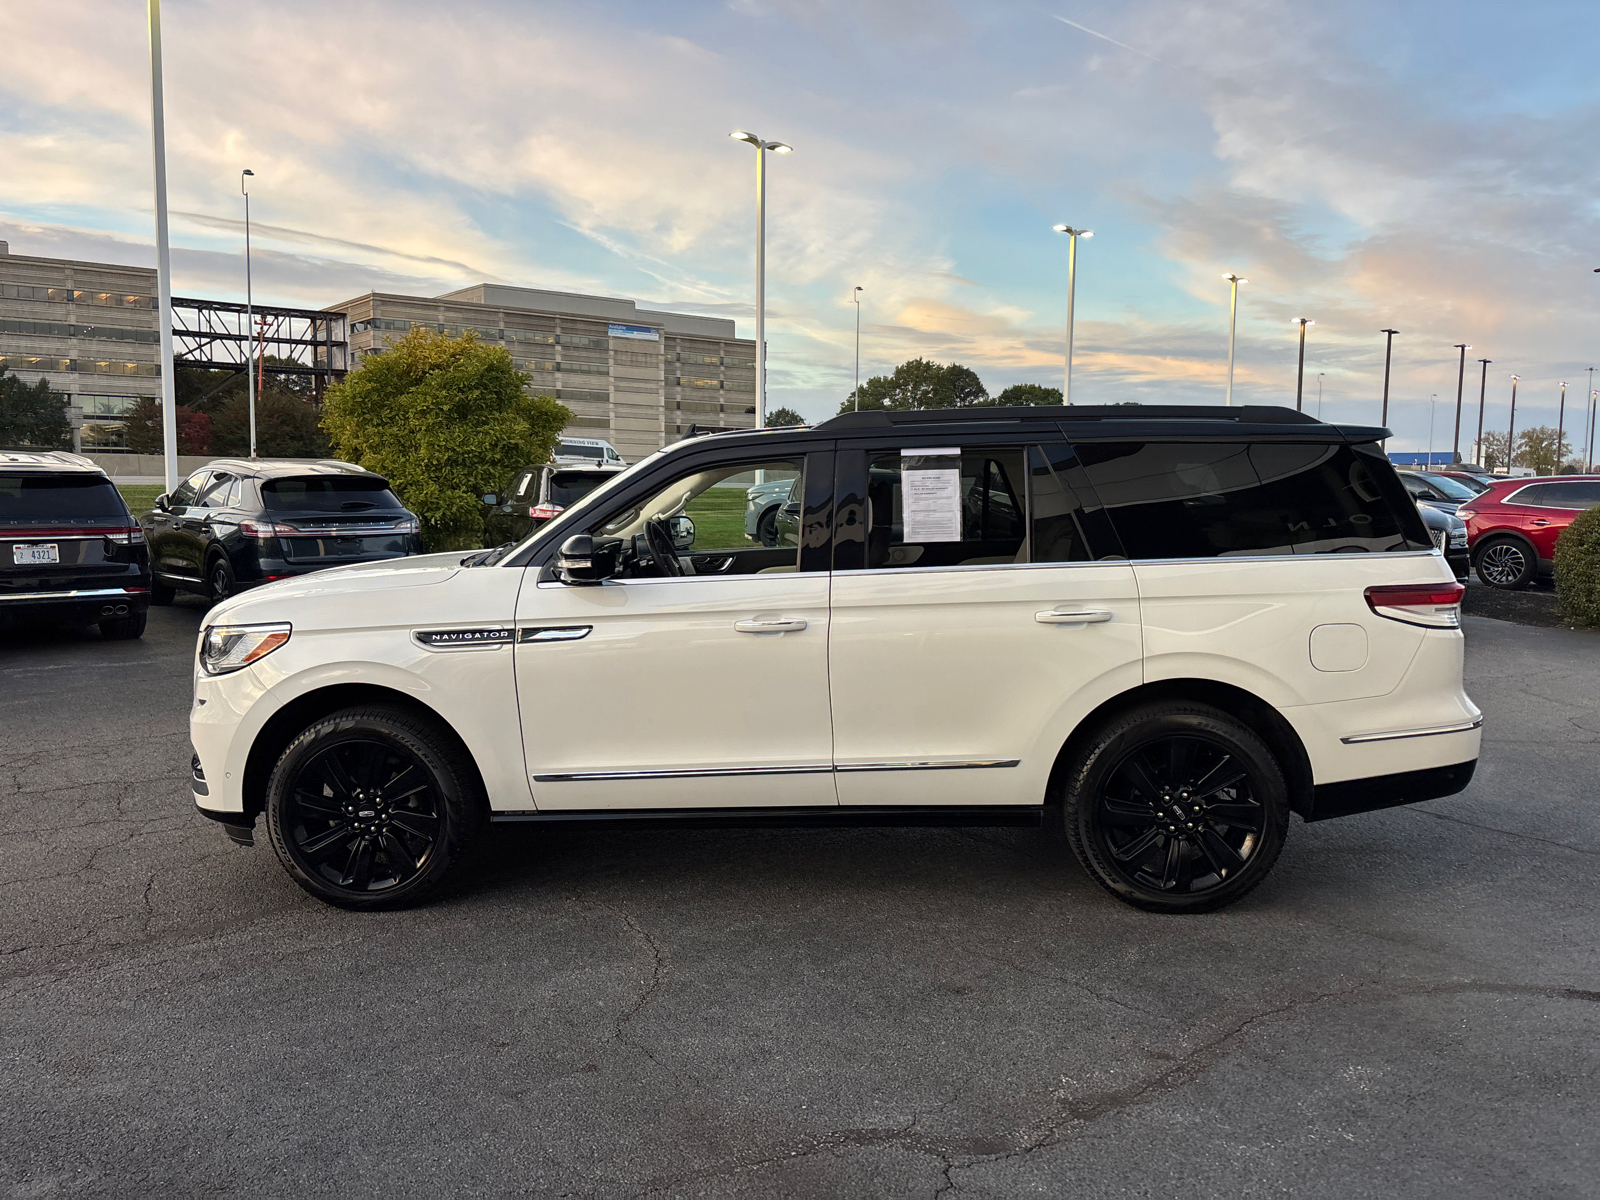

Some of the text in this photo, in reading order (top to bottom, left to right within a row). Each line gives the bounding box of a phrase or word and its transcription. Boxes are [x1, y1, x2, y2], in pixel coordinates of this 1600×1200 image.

[31, 549, 51, 560] 4321
[432, 631, 508, 640] NAVIGATOR
[271, 803, 298, 871] SCORPION
[1083, 818, 1121, 885] SCORPION
